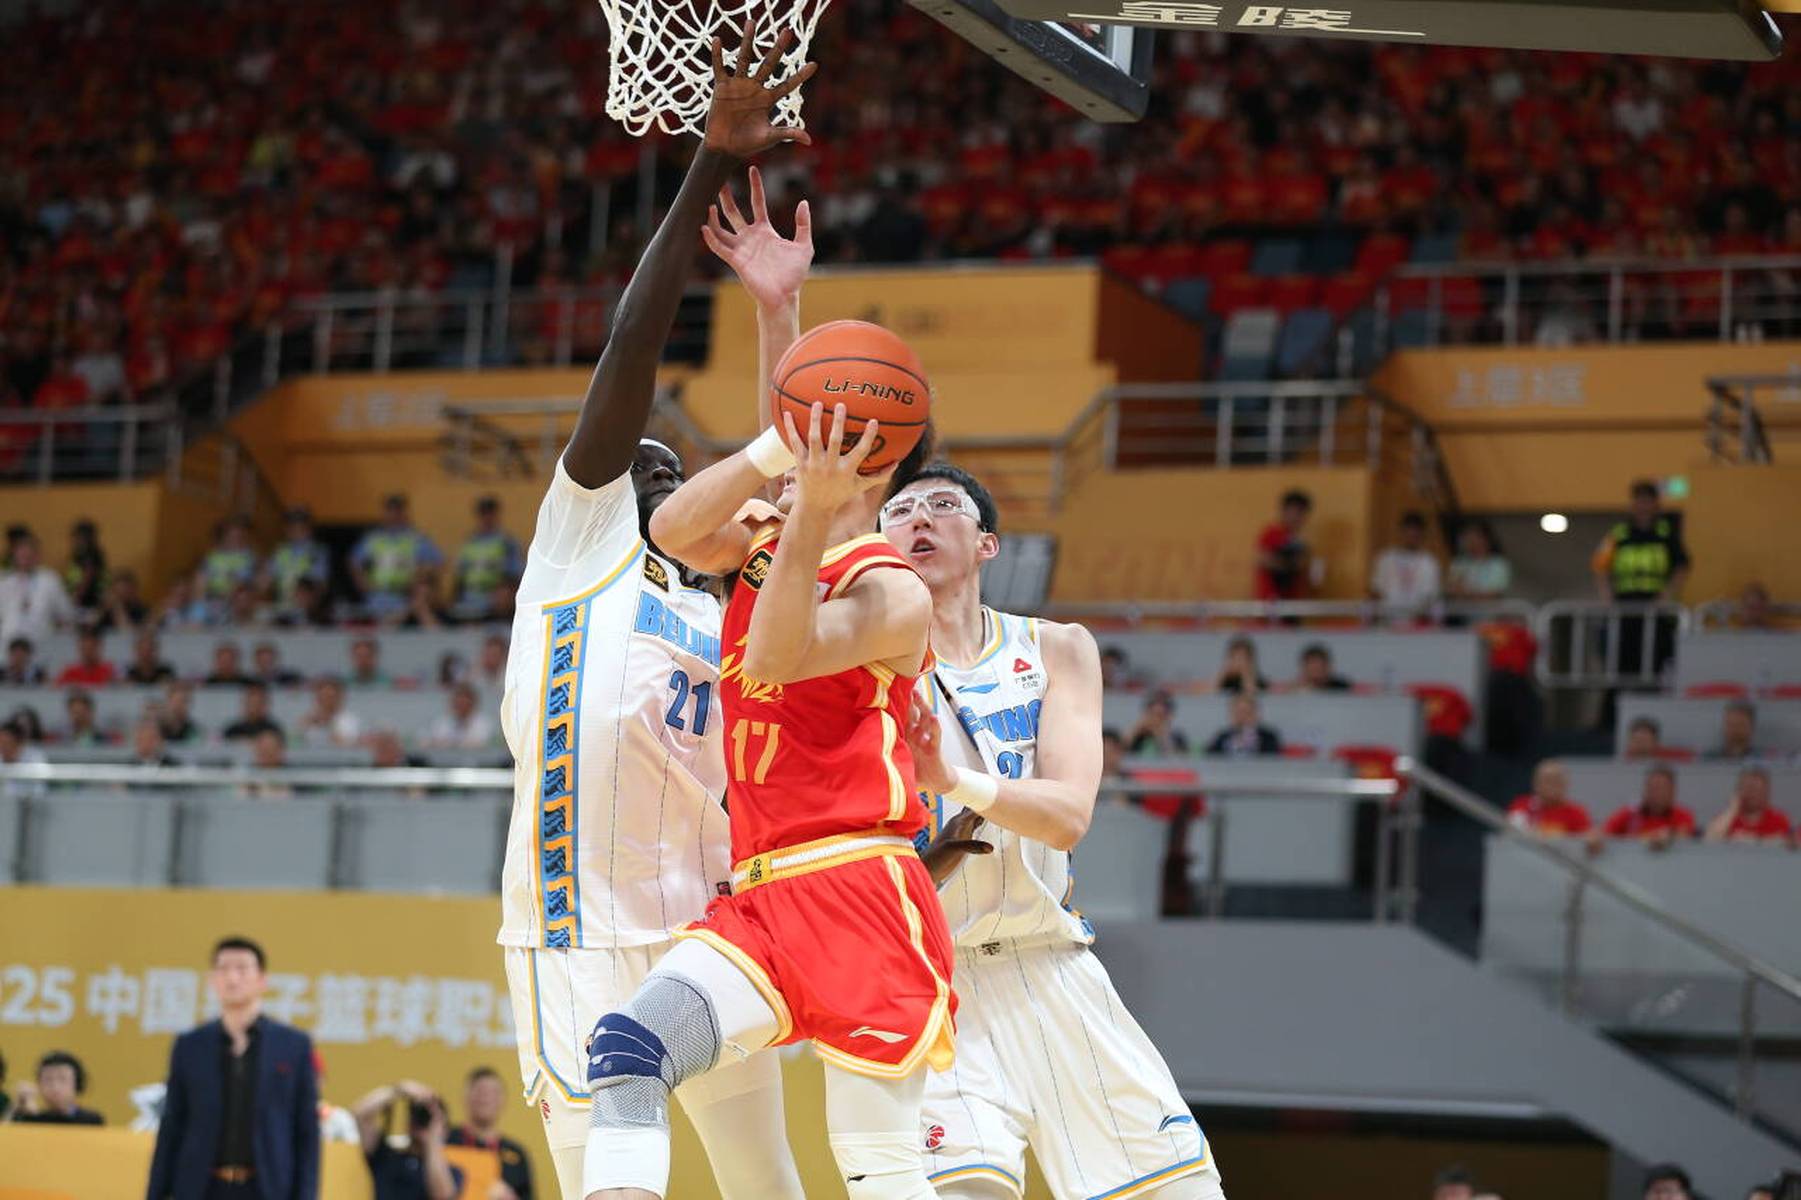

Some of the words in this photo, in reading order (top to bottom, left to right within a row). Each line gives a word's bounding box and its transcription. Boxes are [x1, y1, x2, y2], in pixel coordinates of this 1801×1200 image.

[823, 378, 915, 405] LI-NING
[665, 670, 711, 736] 21
[731, 718, 782, 785] 17
[0, 964, 76, 1027] 25
[86, 963, 516, 1048] 中国子篮球职
